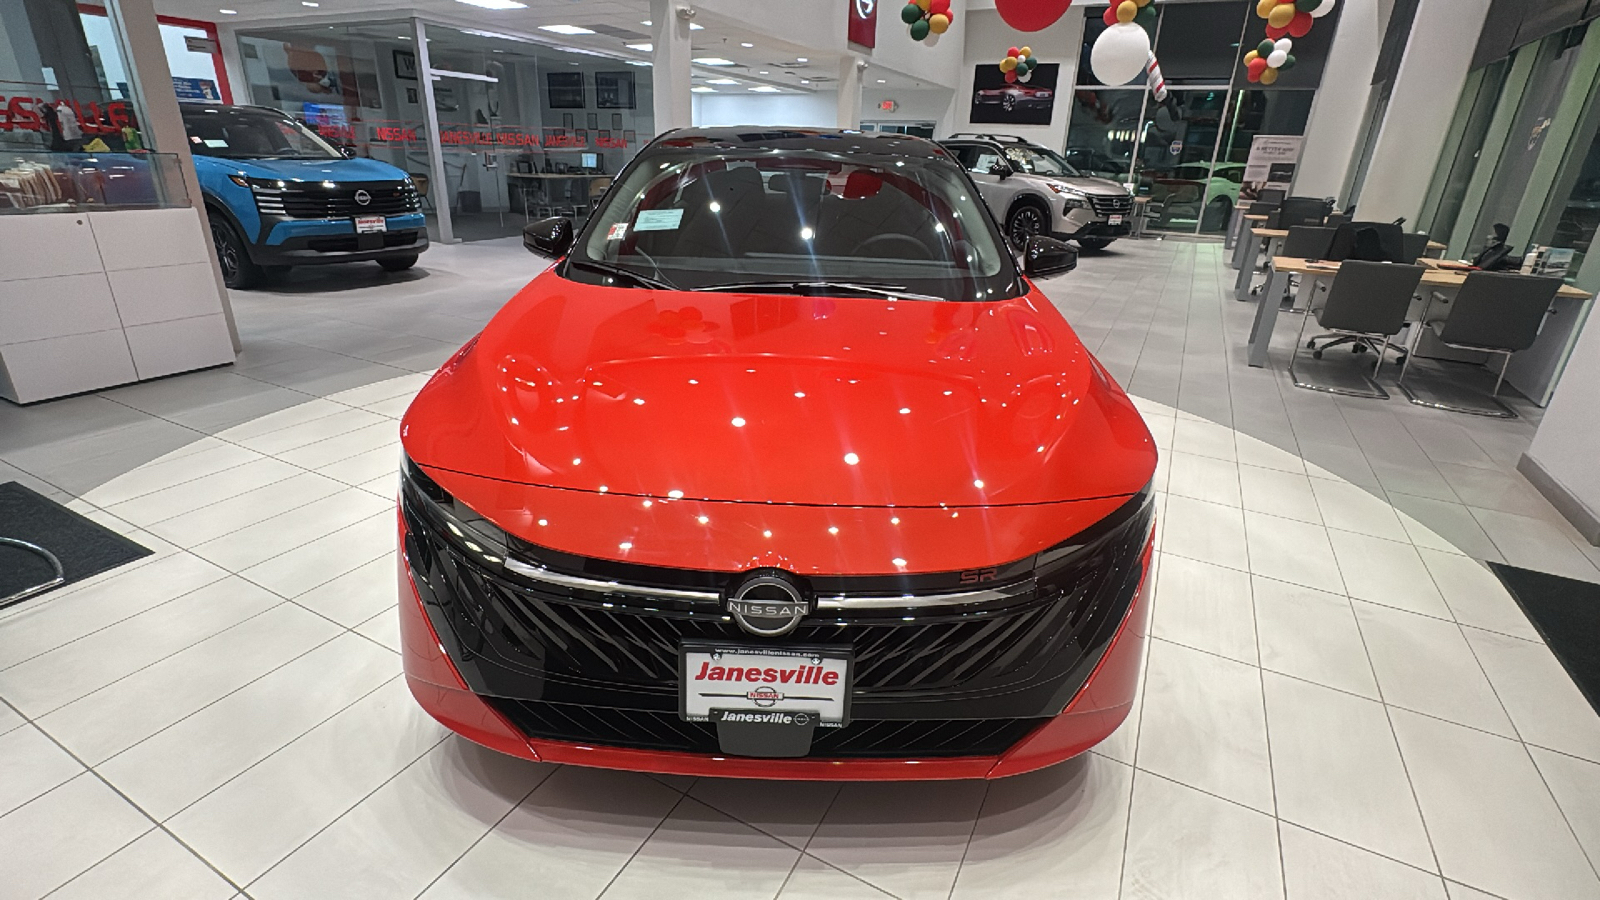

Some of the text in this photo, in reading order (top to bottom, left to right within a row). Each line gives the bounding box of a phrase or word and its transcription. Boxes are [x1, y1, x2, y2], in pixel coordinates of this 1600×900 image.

[376, 127, 417, 142] NISSAN
[496, 131, 540, 147] NISSAN
[960, 567, 997, 584] SR
[728, 600, 807, 616] NISSAN
[714, 647, 820, 658] www.janesvillenissan.com
[694, 661, 839, 686] Janesville
[720, 711, 793, 725] Janesville
